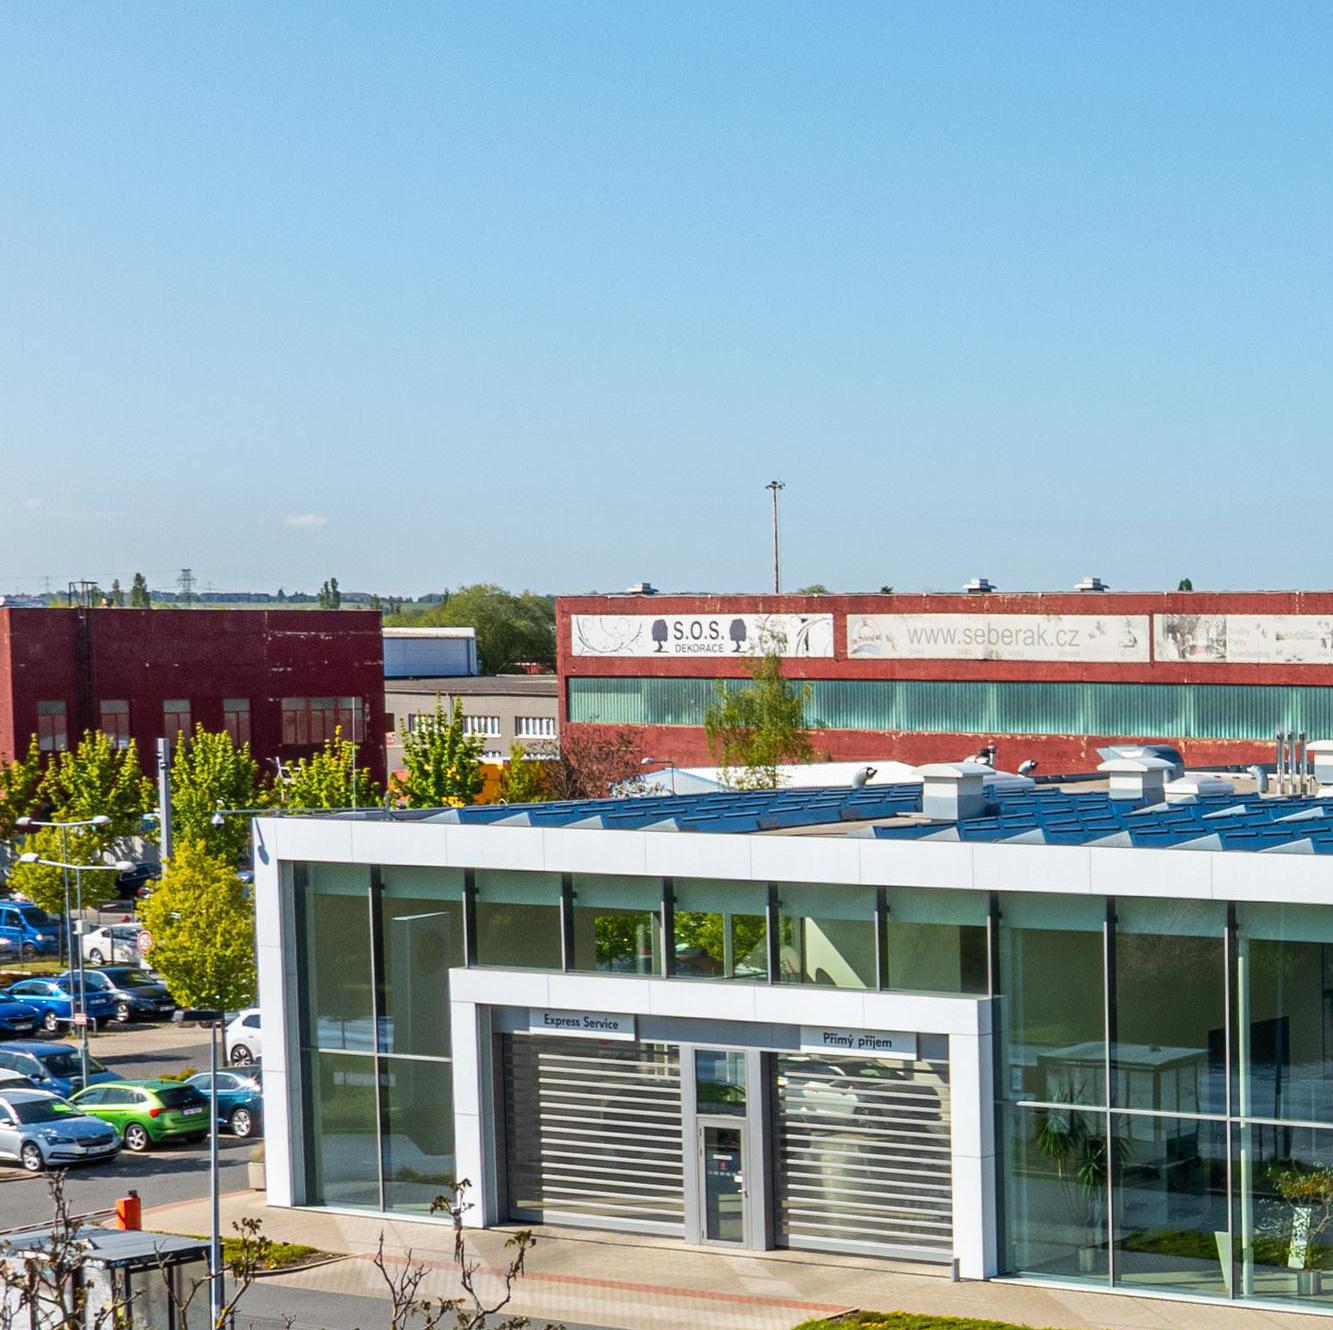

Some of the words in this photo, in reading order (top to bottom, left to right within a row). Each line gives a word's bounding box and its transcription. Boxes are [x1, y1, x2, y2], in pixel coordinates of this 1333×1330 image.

[673, 620, 724, 640] S.O.S.
[907, 623, 1081, 648] www.seberak.cz
[675, 644, 724, 653] DEKORACE
[543, 1013, 580, 1030] Express
[583, 1016, 619, 1030] Service
